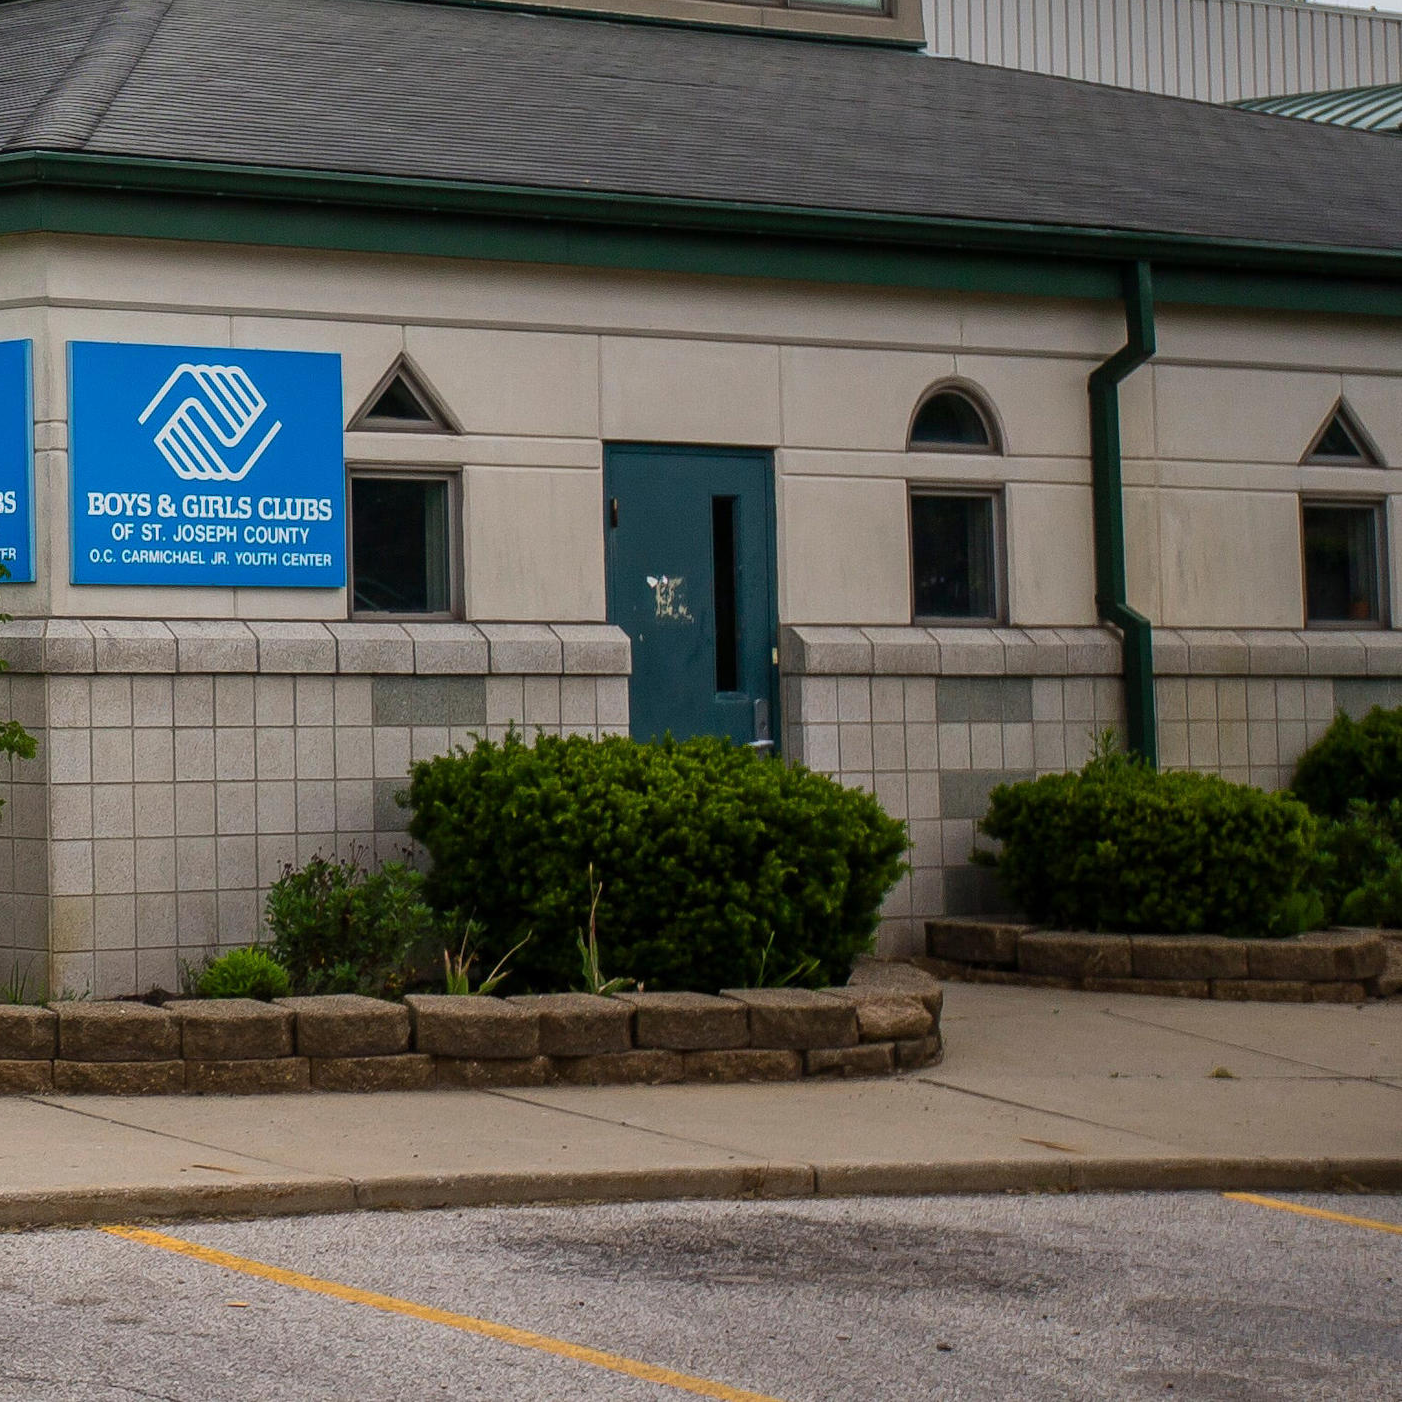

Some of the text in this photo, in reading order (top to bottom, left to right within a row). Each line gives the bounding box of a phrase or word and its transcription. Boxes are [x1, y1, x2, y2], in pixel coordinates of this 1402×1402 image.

[87, 492, 332, 521] BOYS & GIRLS CLUBS
[111, 523, 310, 545] OF ST. JOSEPH COUNTY
[89, 549, 332, 567] O.C. CARMICHAEL JR. YOUTH CENTER
